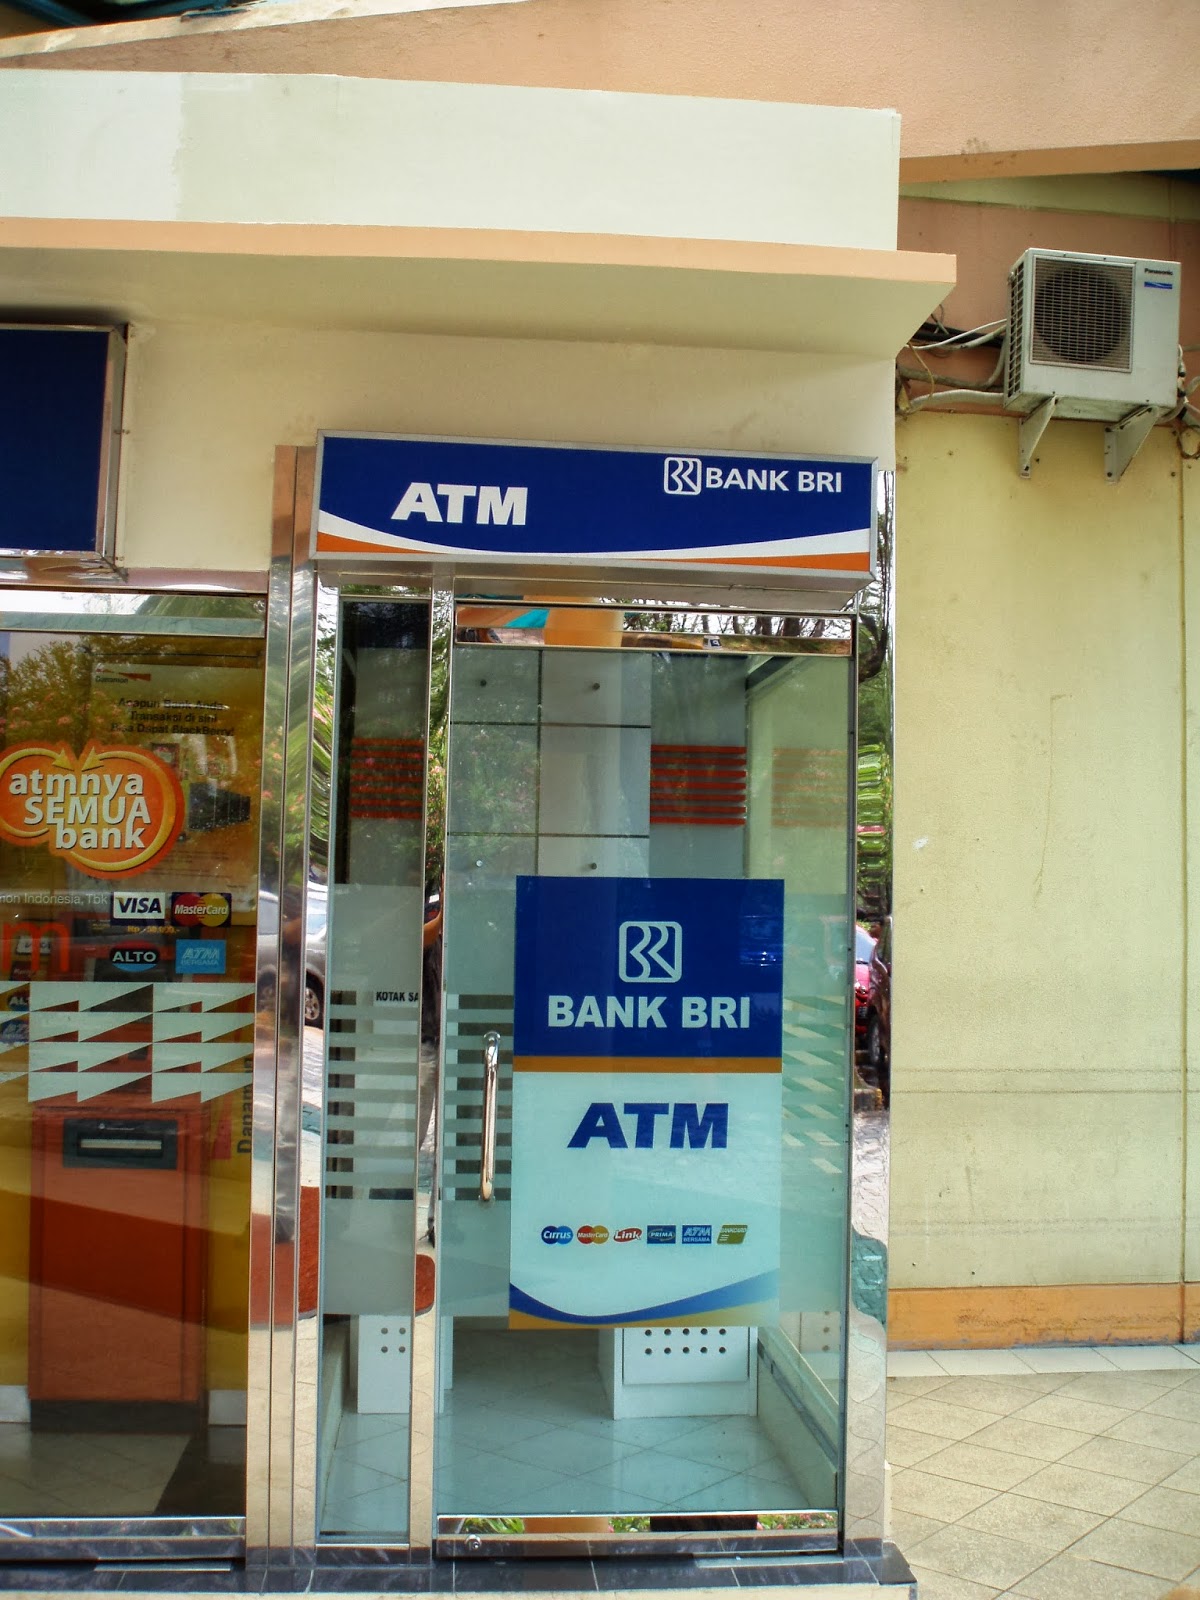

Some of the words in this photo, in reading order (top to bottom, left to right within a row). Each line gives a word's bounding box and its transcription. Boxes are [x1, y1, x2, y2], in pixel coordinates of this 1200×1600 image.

[705, 467, 789, 493] BANK
[798, 470, 843, 494] BRI
[391, 482, 528, 526] ATM
[9, 769, 144, 801] atmnya
[23, 796, 151, 825] SEMUA
[55, 818, 146, 850] bank
[116, 896, 163, 915] VISA
[174, 903, 229, 916] MasterCard
[112, 951, 157, 963] ALTO
[182, 947, 220, 959] ATM
[376, 991, 405, 1002] KOTAK
[548, 995, 667, 1028] BANK
[681, 996, 750, 1029] BRI
[566, 1102, 729, 1149] ATM
[543, 1230, 571, 1239] Cirrus
[614, 1229, 640, 1240] Link
[683, 1226, 711, 1237] ATM
